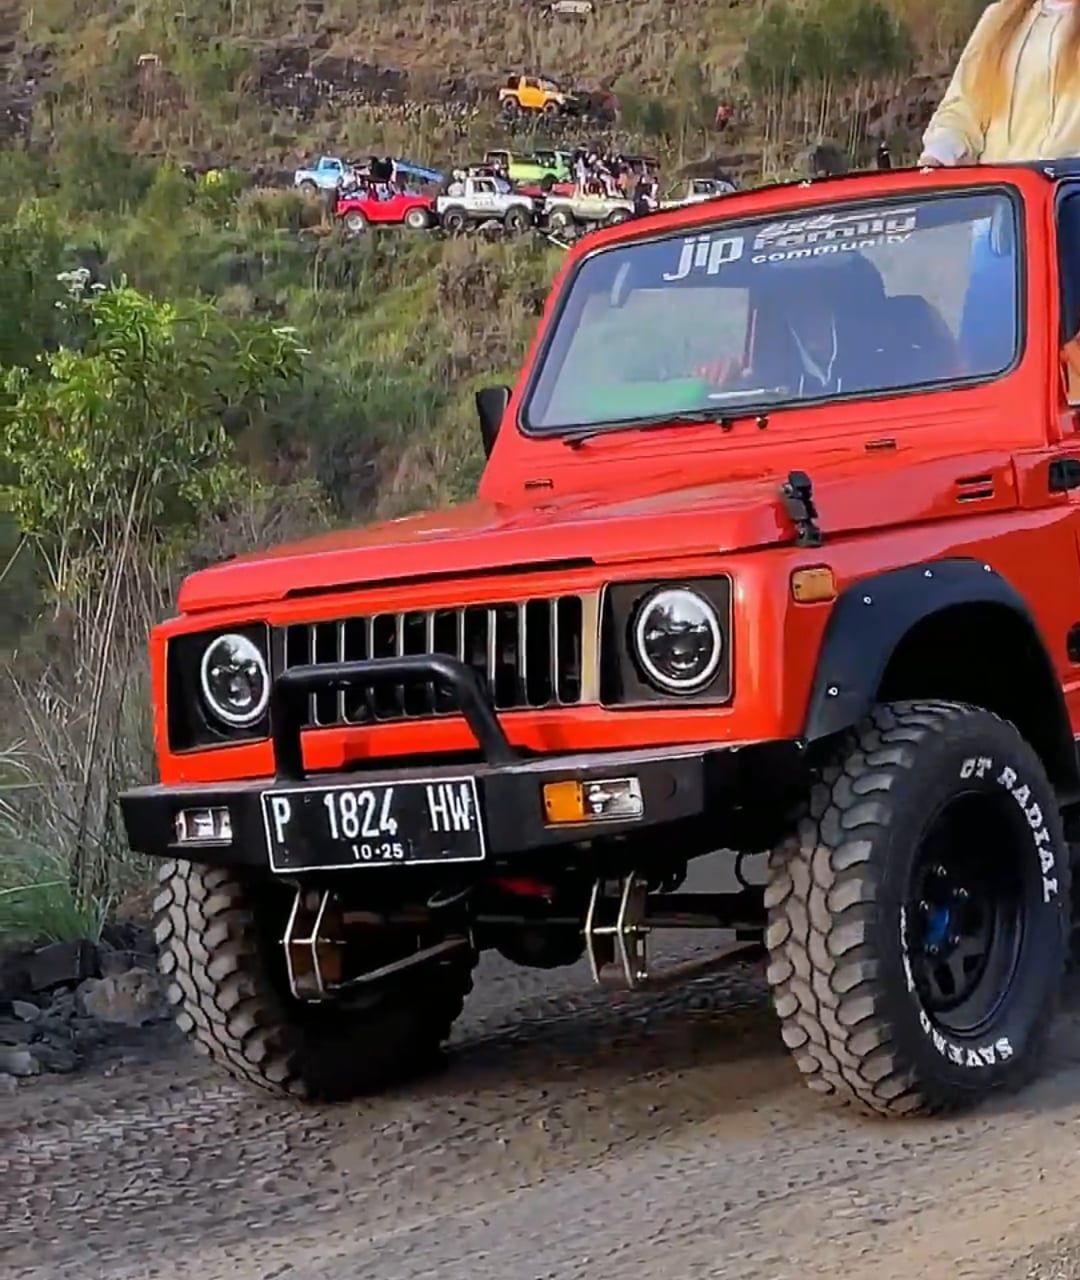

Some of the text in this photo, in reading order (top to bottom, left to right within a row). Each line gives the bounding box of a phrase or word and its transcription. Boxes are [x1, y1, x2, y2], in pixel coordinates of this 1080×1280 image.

[751, 232, 912, 265] community
[271, 783, 472, 844] P 1824 HW
[996, 765, 1059, 903] RADIAL
[919, 1008, 1014, 1068] SAVERO
